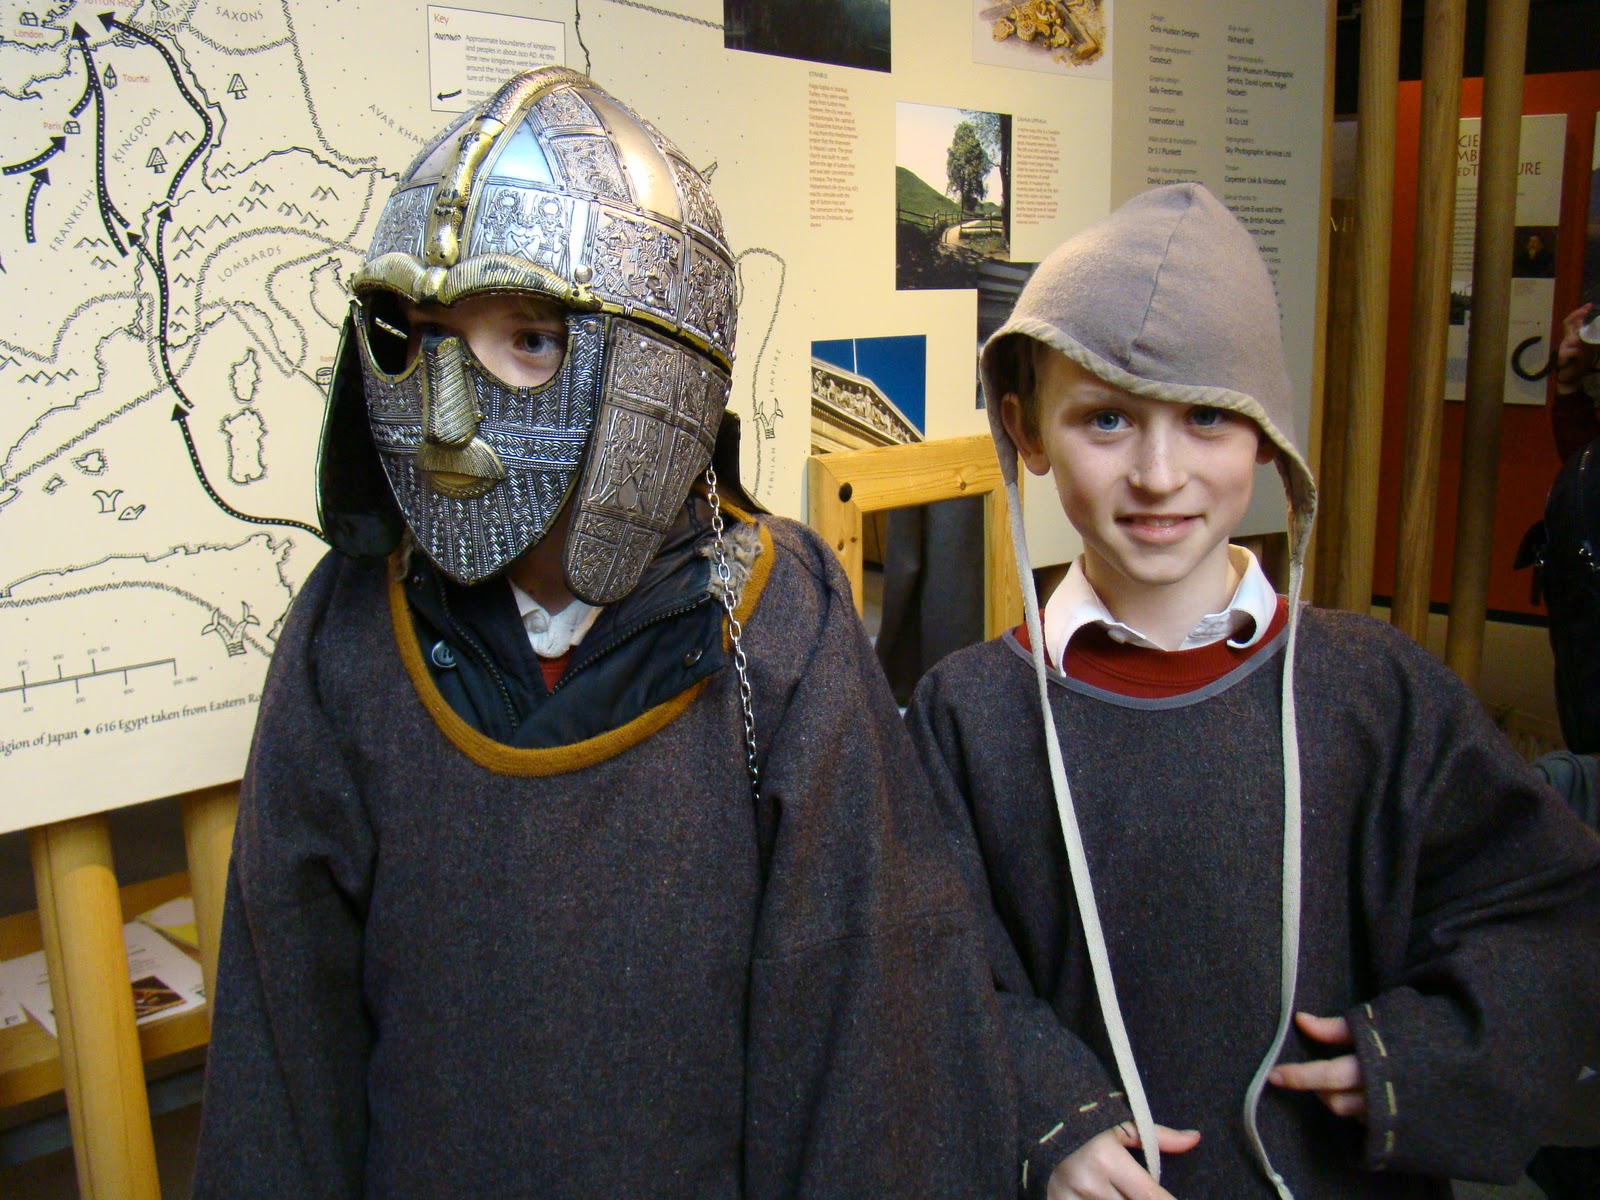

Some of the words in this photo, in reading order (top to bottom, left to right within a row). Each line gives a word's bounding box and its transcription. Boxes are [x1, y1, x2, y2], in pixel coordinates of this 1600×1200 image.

[215, 6, 264, 23] SAXONS
[433, 13, 450, 27] Key
[14, 29, 44, 39] London
[465, 44, 475, 52] and
[123, 74, 150, 83] Tournai
[43, 121, 62, 131] Paris
[112, 107, 161, 163] KINGDOM
[368, 103, 394, 129] AVAR
[398, 127, 429, 146] KHAN
[49, 189, 96, 251] FRANKISH
[217, 245, 282, 283] LOMBARDS
[769, 349, 781, 393] EMPIRE
[767, 447, 776, 496] PERSIAN
[0, 738, 30, 757] igion
[33, 734, 44, 746] of
[47, 730, 79, 747] Japan
[96, 723, 117, 734] 616
[119, 715, 149, 733] Egypt
[151, 709, 180, 724] taken
[182, 703, 208, 718] from
[209, 697, 246, 712] Eastern
[248, 693, 262, 706] Ro
